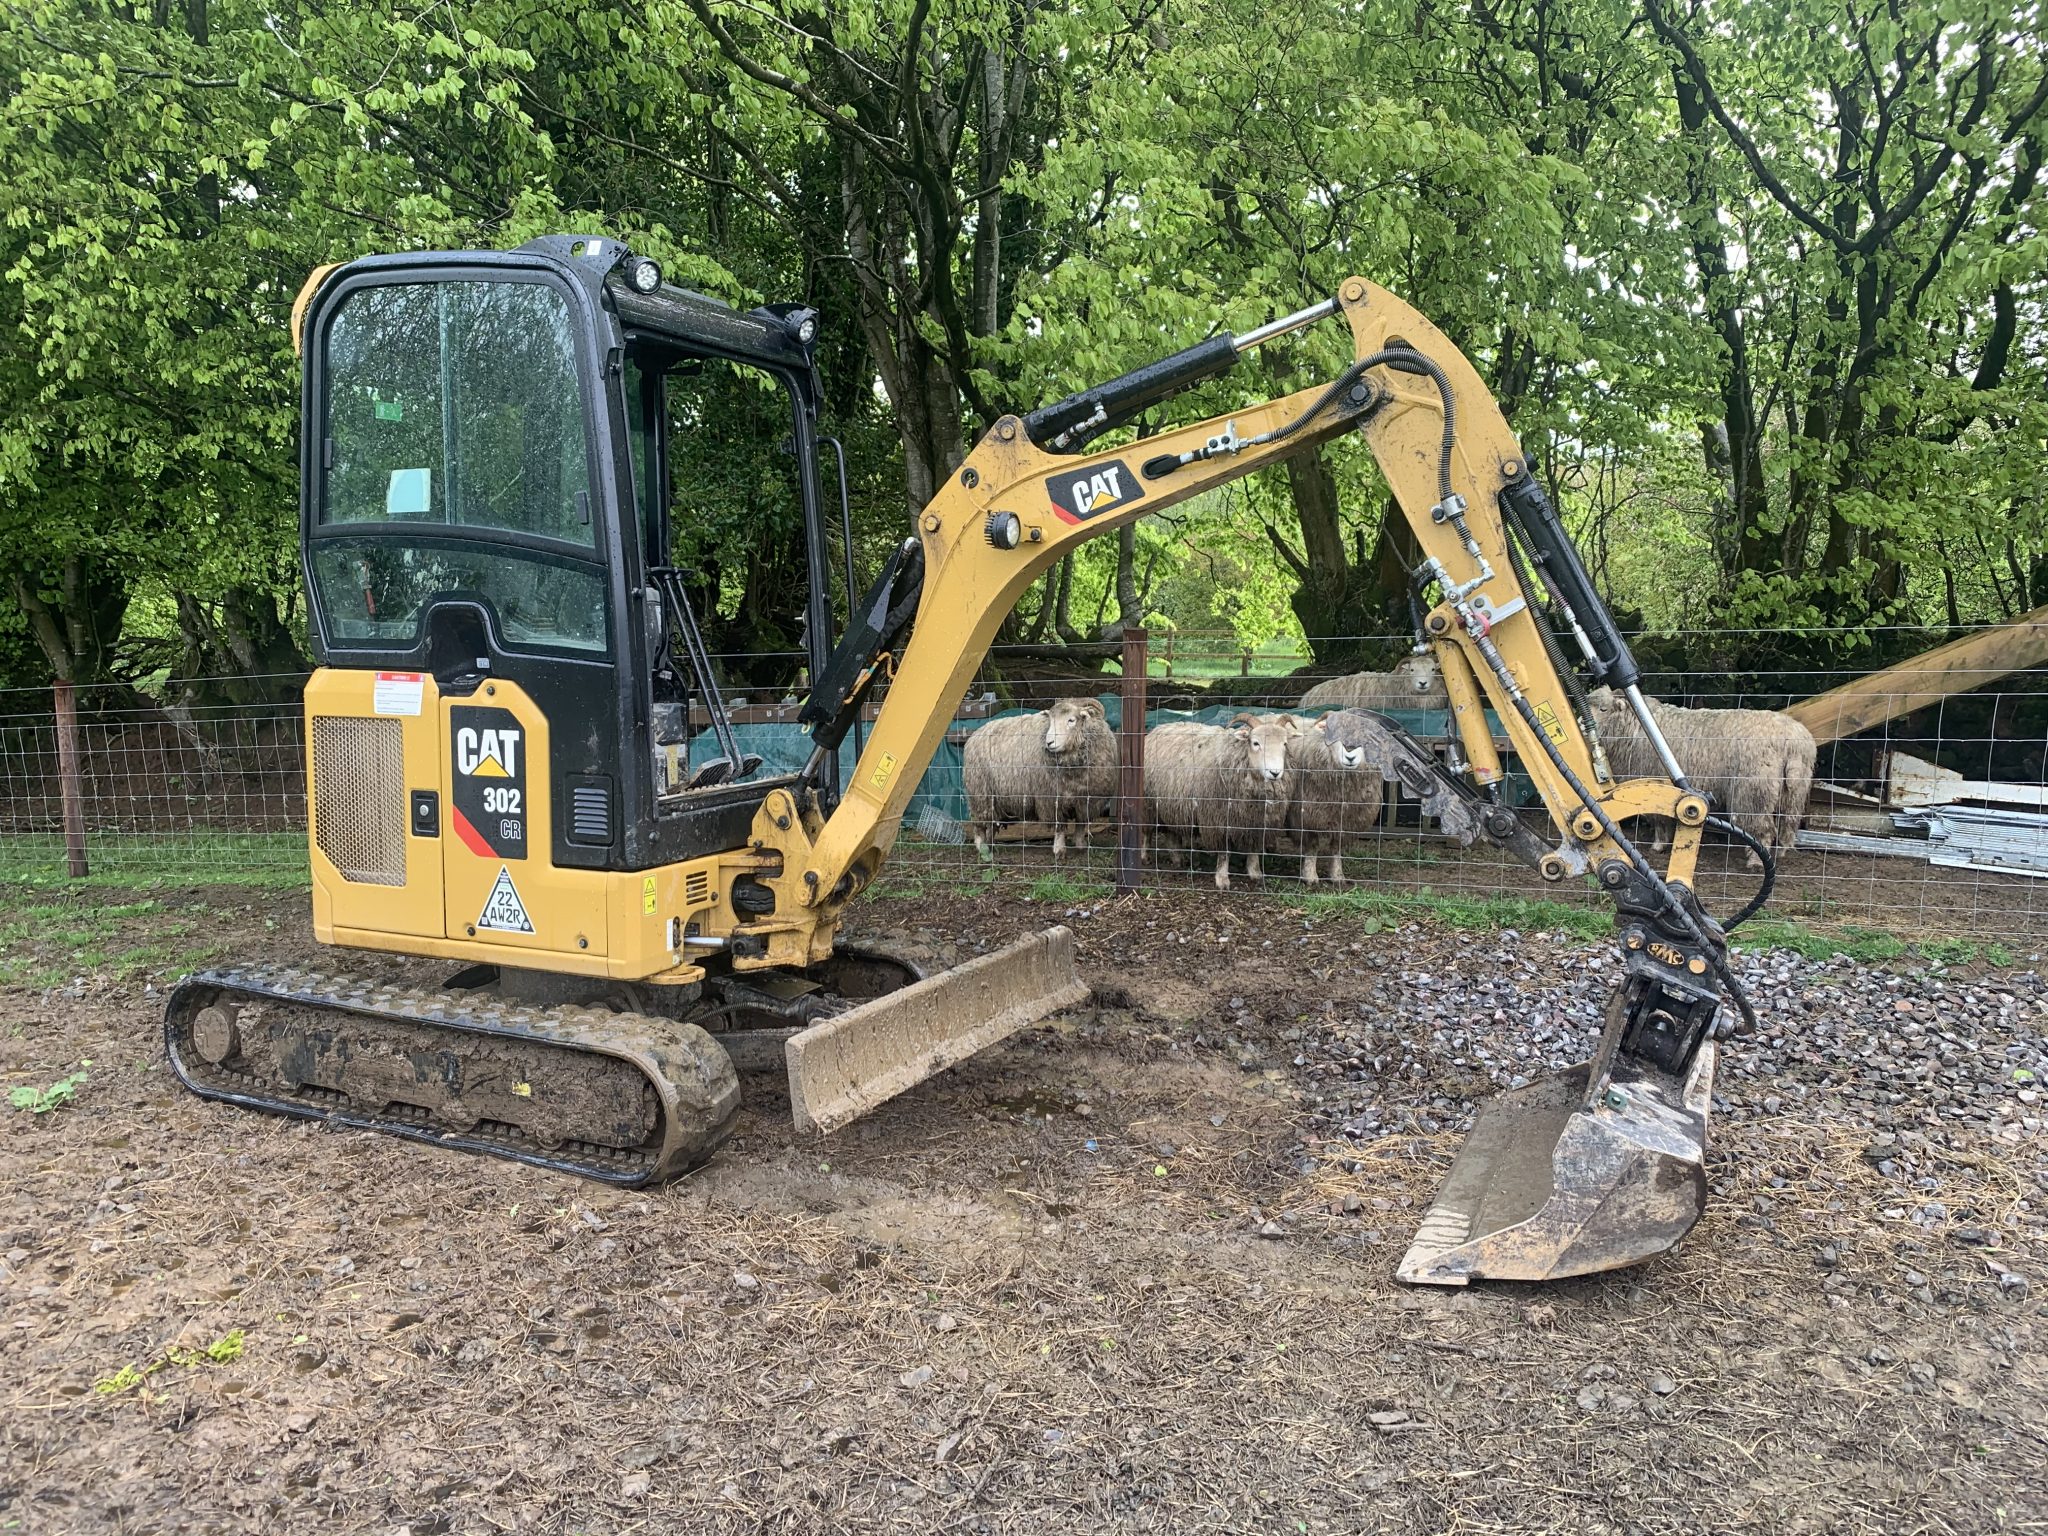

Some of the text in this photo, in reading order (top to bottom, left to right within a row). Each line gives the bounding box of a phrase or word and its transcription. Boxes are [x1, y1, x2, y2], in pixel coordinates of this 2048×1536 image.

[1072, 466, 1122, 514] CAT
[457, 727, 519, 777] CAT
[484, 787, 521, 813] 302
[501, 820, 522, 839] CR
[497, 891, 513, 907] 22
[490, 907, 521, 924] AW2R
